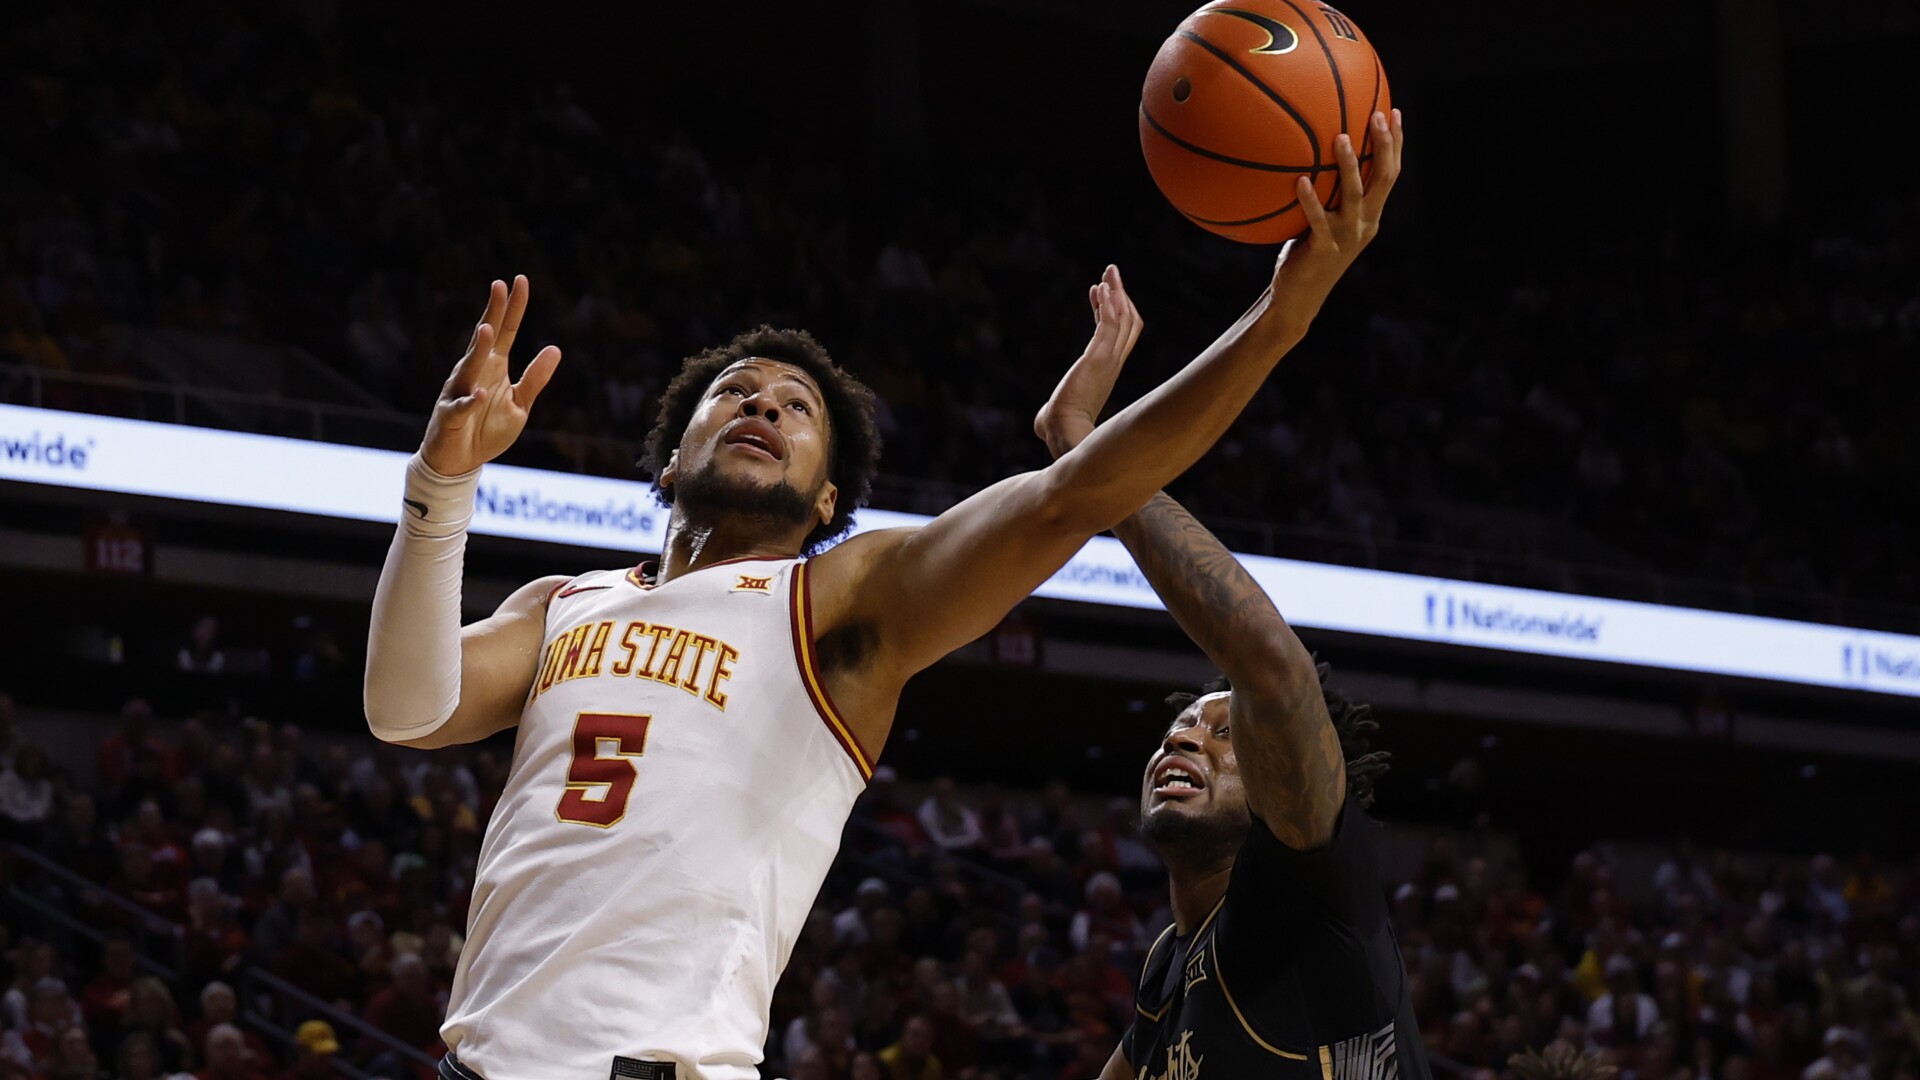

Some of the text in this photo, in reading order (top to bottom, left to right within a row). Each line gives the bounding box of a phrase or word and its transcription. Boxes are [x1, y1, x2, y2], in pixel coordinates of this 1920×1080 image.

[97, 538, 144, 573] 112
[611, 621, 740, 712] STATE
[554, 711, 652, 829] 5
